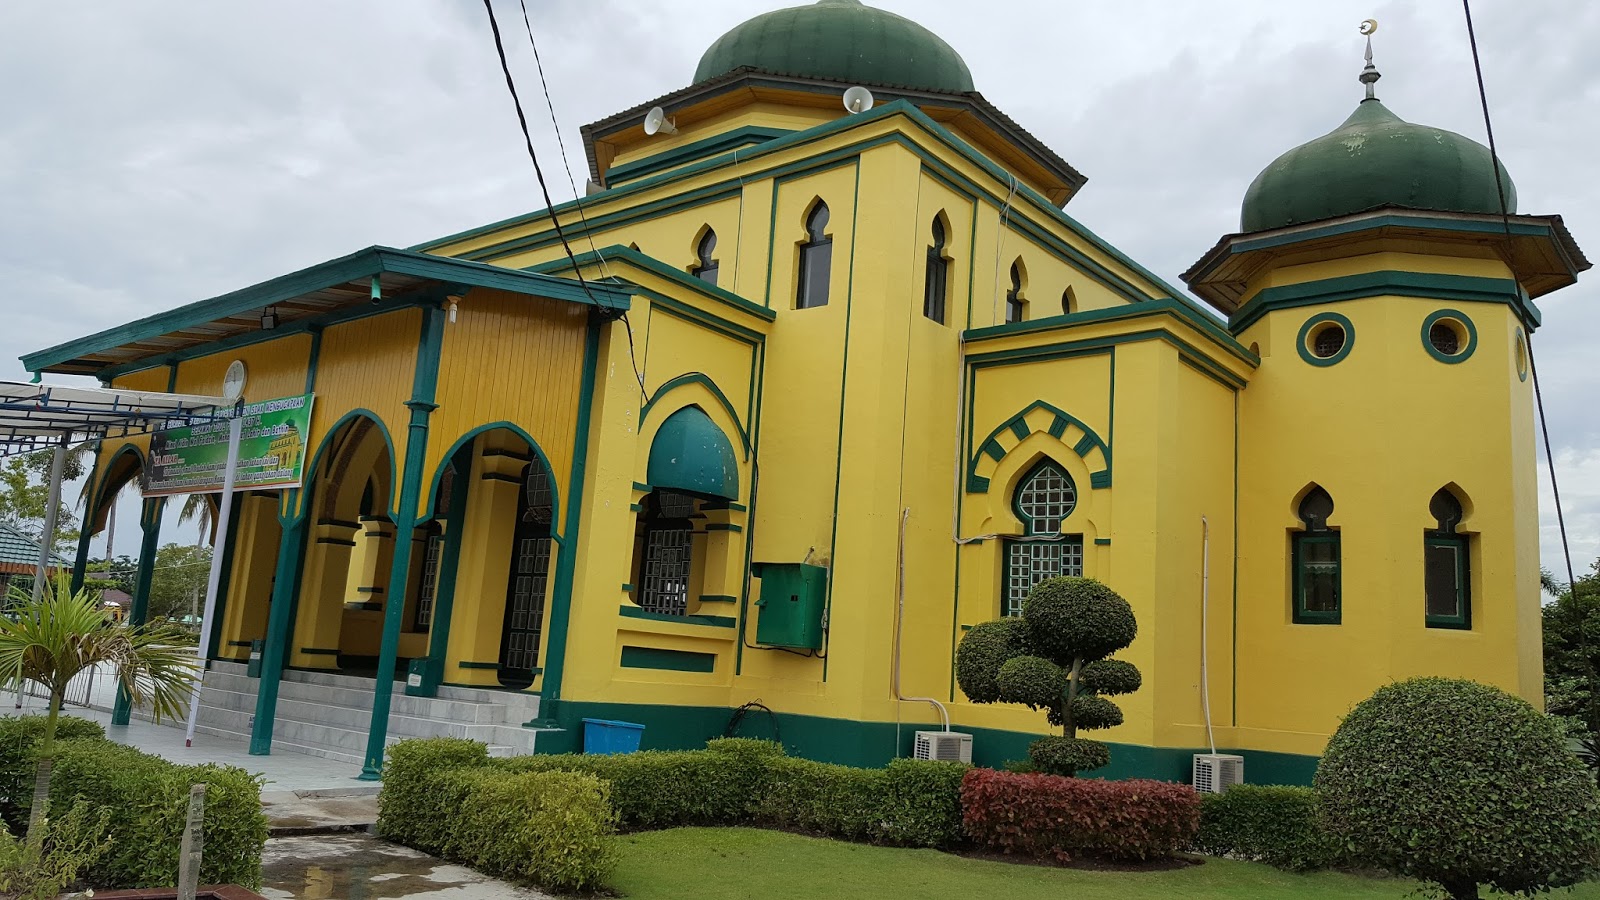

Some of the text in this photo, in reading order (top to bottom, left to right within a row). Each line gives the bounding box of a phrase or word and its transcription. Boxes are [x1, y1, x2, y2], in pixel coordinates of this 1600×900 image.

[251, 397, 305, 415] SIAK MENGUCAPKAN
[261, 426, 271, 437] dan
